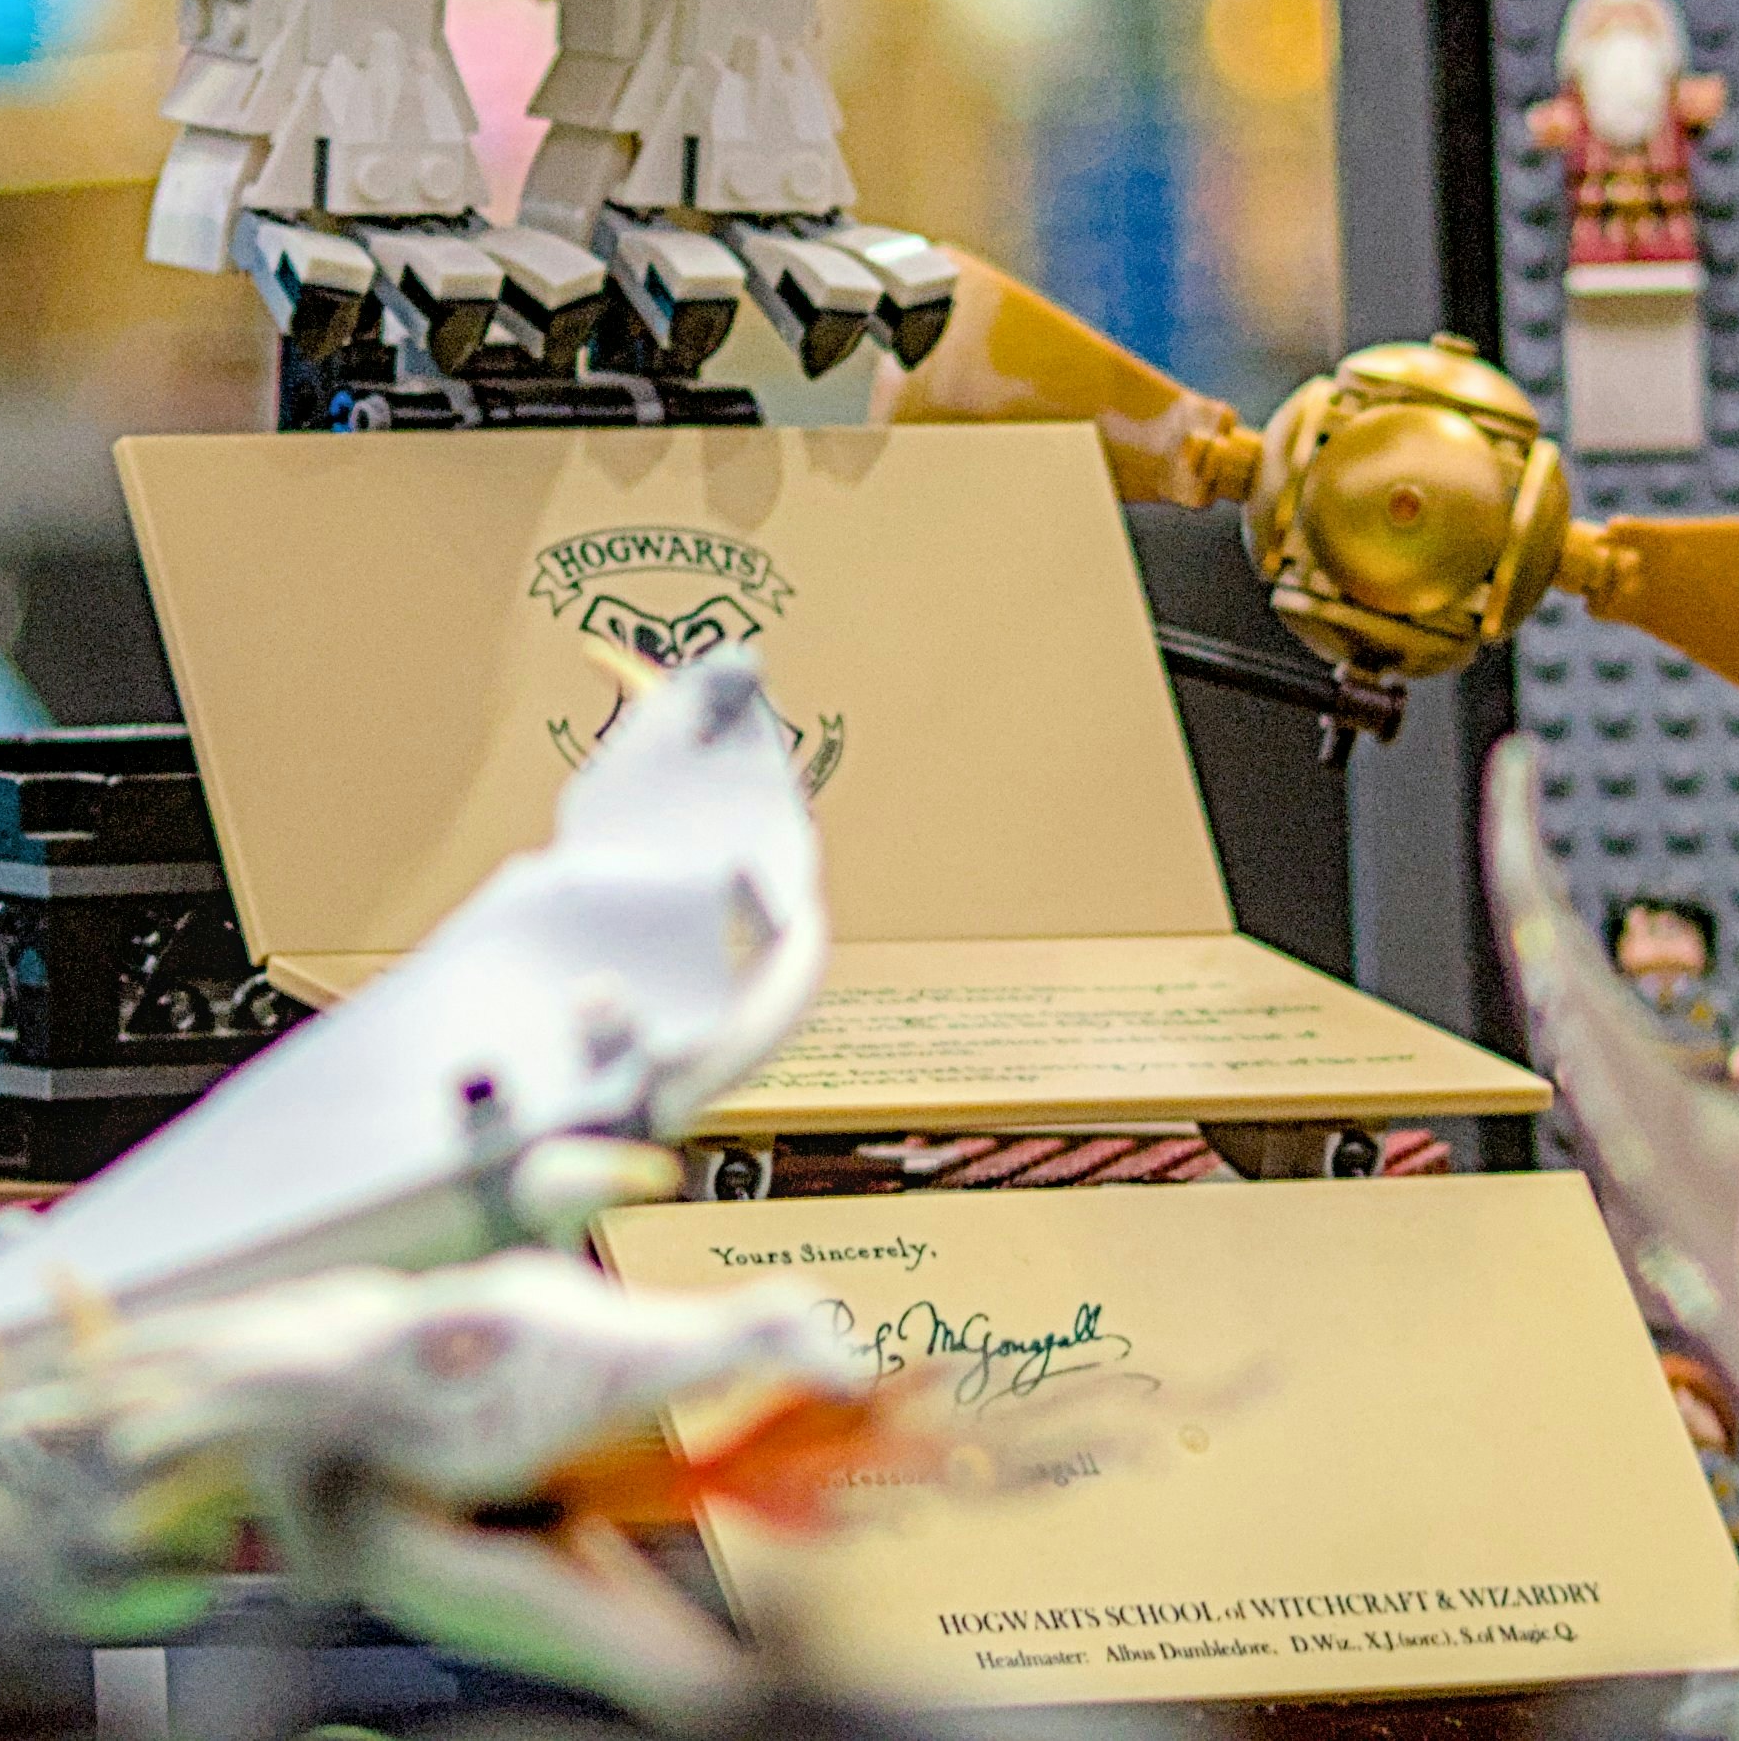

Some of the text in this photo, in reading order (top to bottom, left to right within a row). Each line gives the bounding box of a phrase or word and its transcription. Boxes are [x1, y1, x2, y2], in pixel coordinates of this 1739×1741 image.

[550, 535, 759, 578] HOGWARTS
[710, 1245, 792, 1267] Yours
[938, 1582, 1603, 1636] HOGWARTS SCHOOL of WITCHCRAFT & WIZARDRY
[1106, 1644, 1157, 1663] Albus
